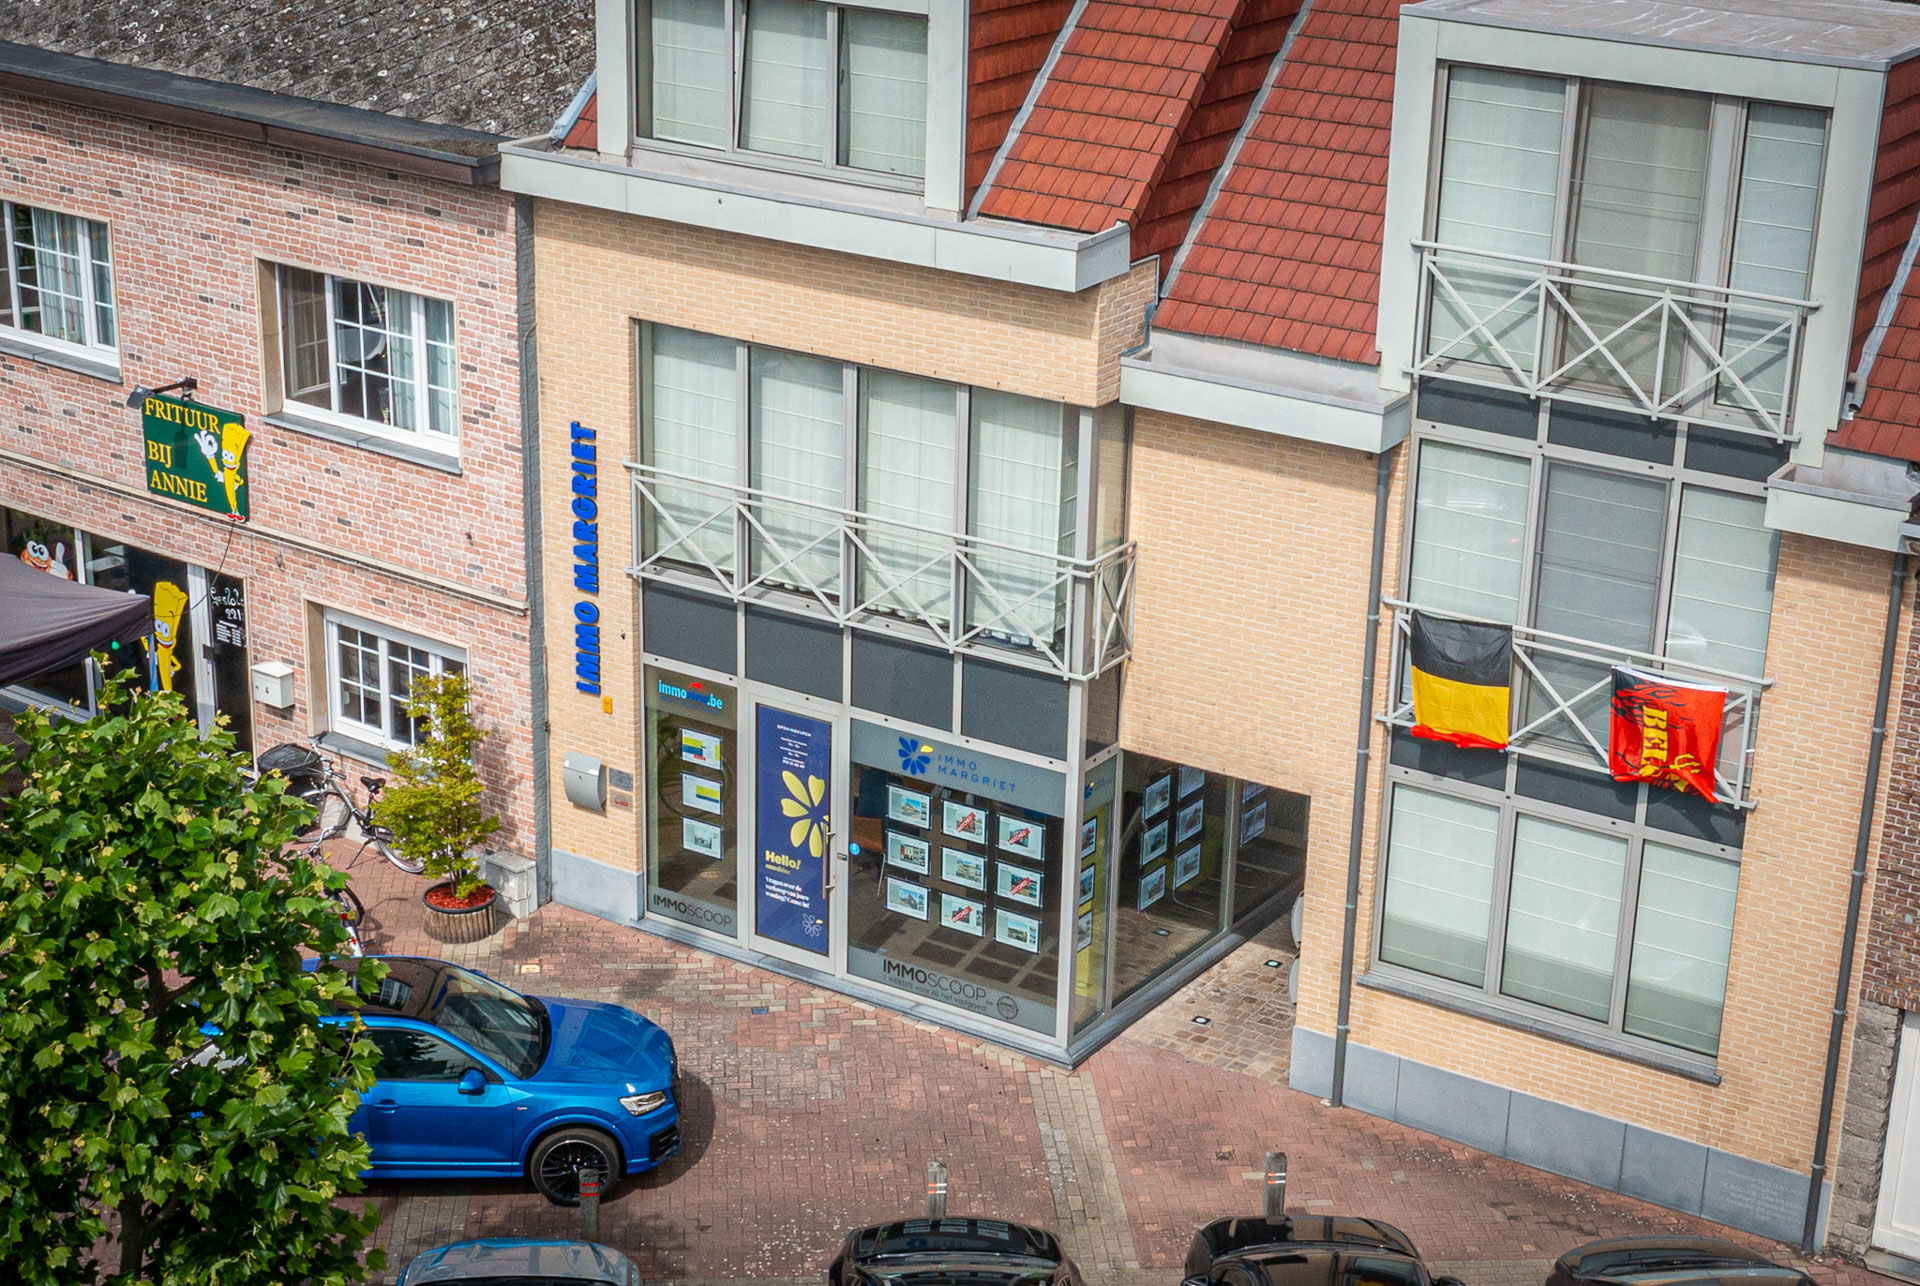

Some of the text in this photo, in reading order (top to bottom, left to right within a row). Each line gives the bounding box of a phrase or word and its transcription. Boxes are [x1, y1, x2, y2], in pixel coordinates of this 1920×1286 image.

[145, 397, 220, 434] FRITUUR
[148, 440, 172, 468] BIJ
[150, 470, 208, 502] ANNIE
[571, 421, 600, 695] IMMO MARGRIET
[938, 753, 977, 771] IMMO
[938, 765, 1016, 792] MARGRIET
[765, 850, 801, 870] Hello!
[653, 894, 732, 926] IMMOSCOOP
[883, 959, 986, 1000] IMMOSCOOP
